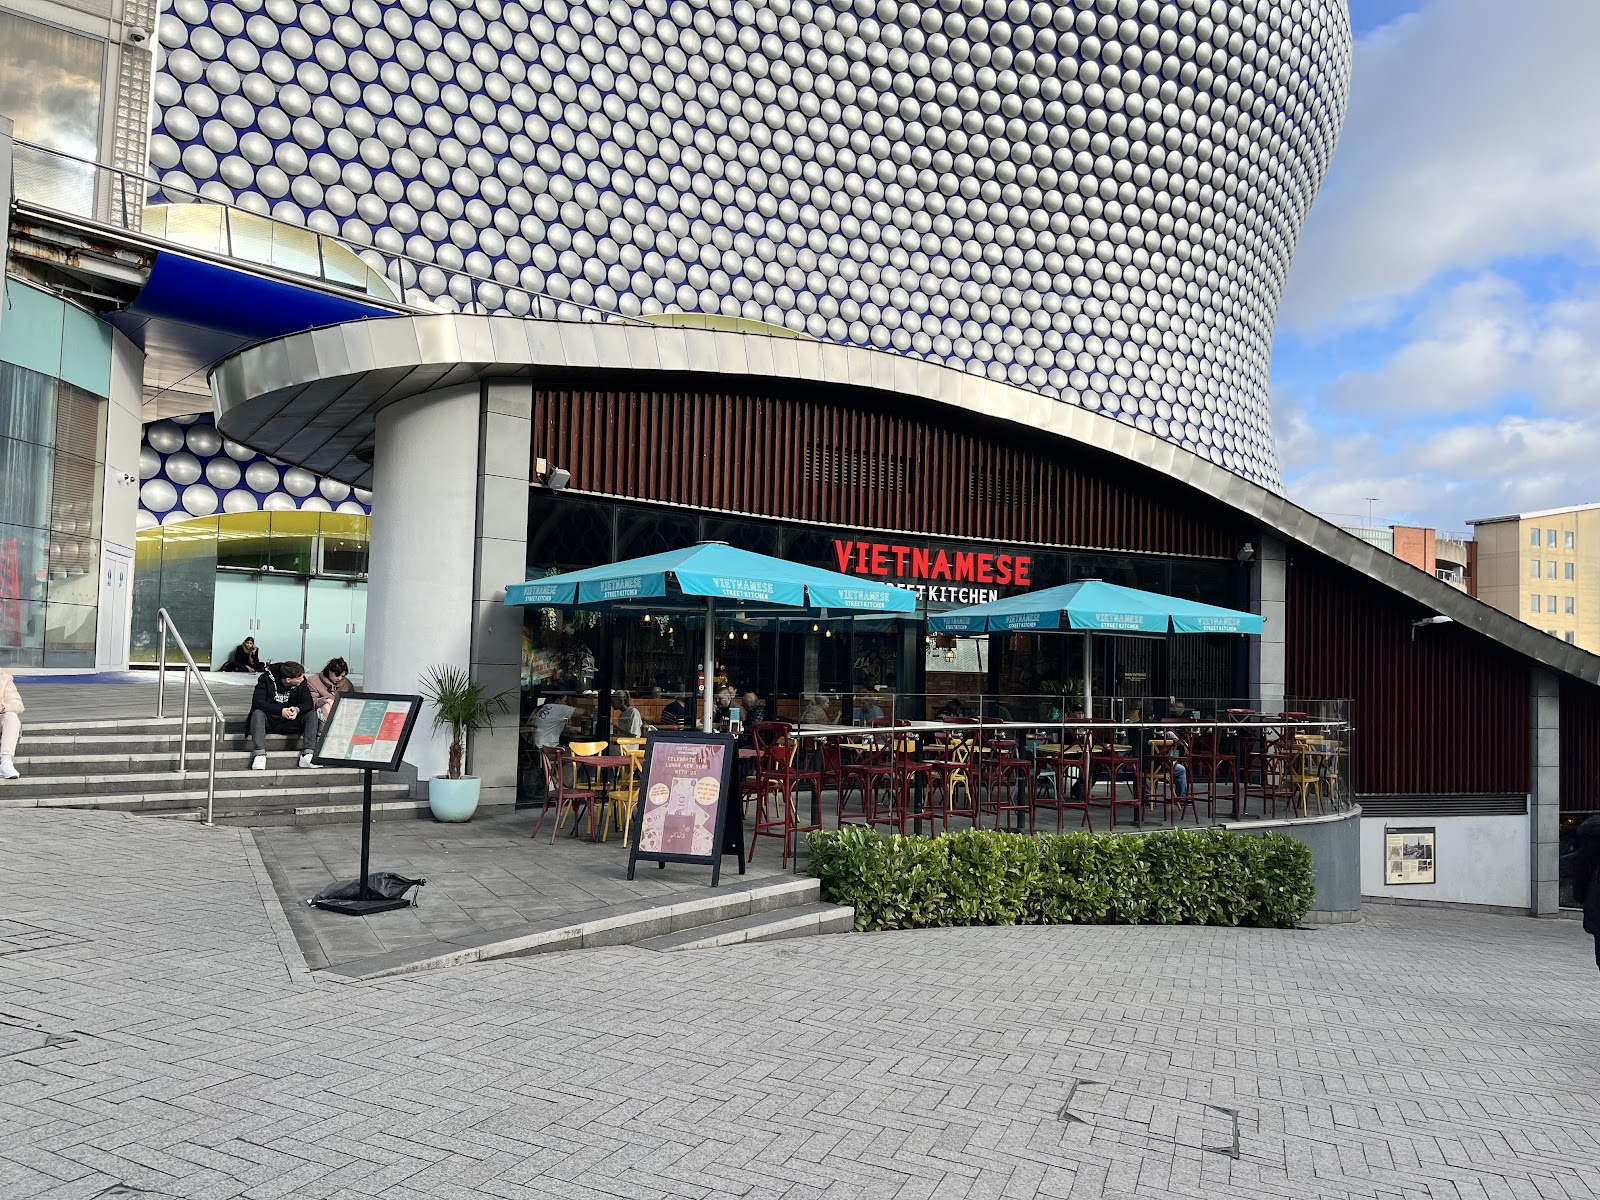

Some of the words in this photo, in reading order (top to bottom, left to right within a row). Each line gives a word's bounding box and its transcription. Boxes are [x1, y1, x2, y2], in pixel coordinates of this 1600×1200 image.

[833, 540, 1031, 586] VIETNAMESE
[600, 577, 641, 591] VIETNAMESE
[712, 577, 774, 594] VIETNAMESE
[524, 585, 557, 596] VIETNAMESE
[604, 590, 619, 598] STREET
[620, 589, 638, 597] KITCHEN
[722, 589, 743, 597] STREET
[744, 590, 769, 600] KITCHEN
[838, 589, 890, 602] VIETNAMESE
[928, 585, 998, 604] KITCHEN
[1006, 613, 1041, 623] VIETNAMESE
[1096, 613, 1144, 625] VIETNAMESE
[1197, 617, 1240, 626] VIETNAMESE
